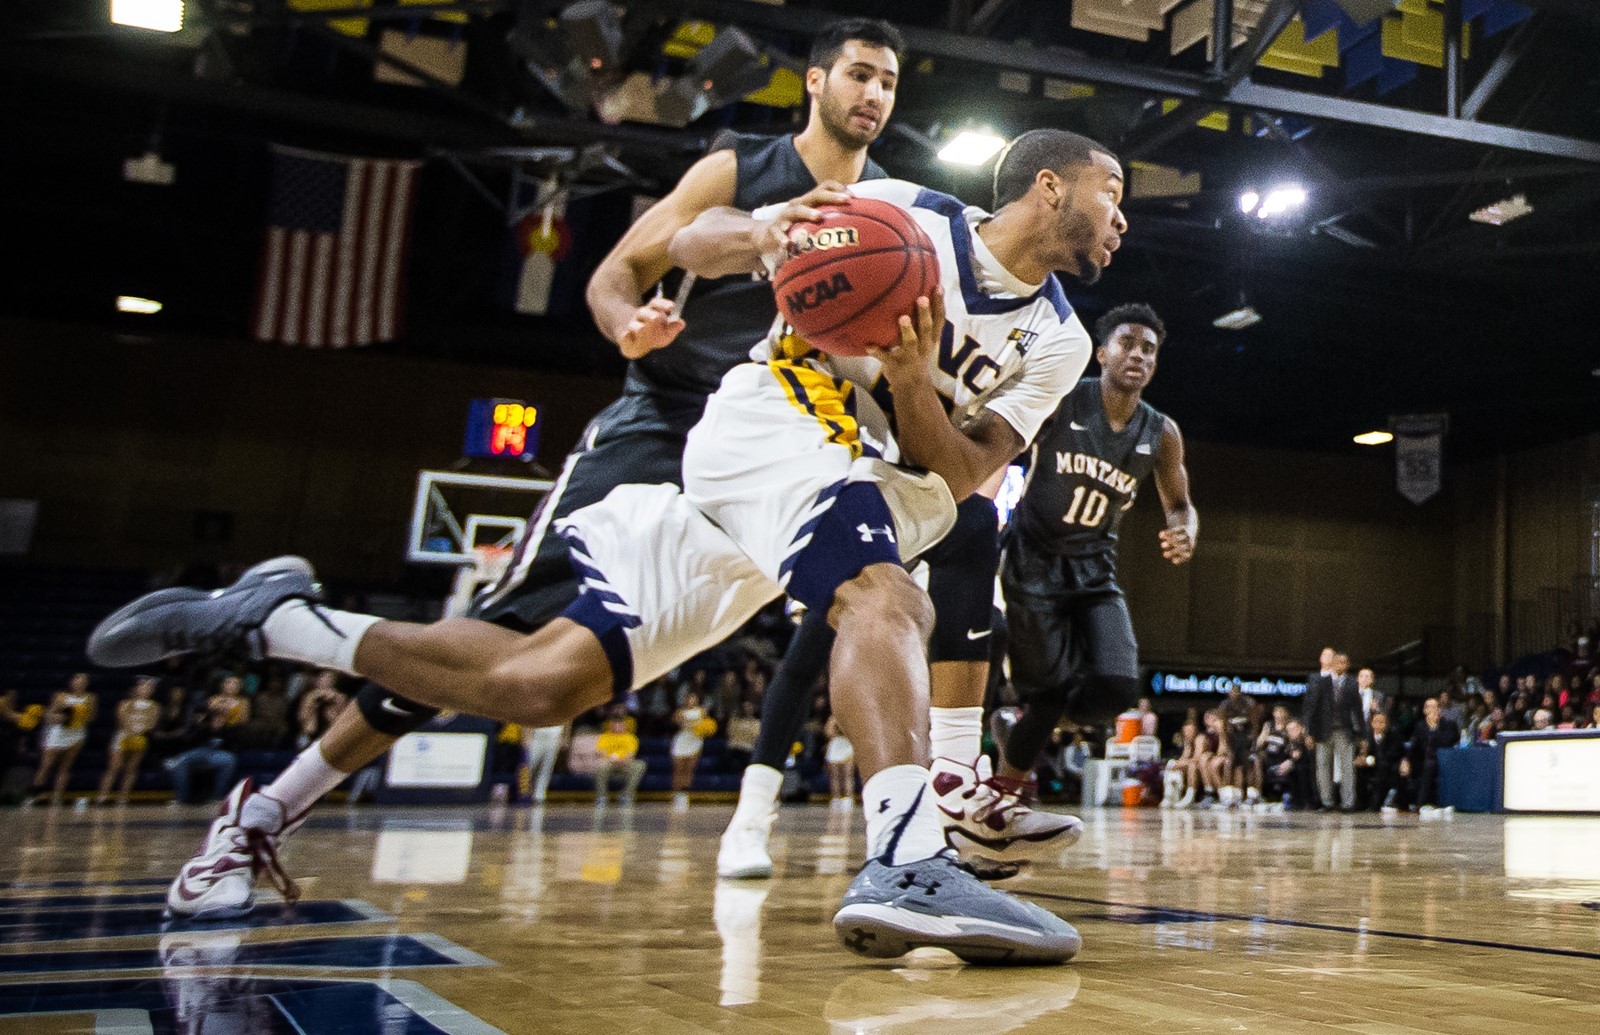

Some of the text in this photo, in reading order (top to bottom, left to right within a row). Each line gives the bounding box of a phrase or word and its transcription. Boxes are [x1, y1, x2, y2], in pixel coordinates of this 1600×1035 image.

[786, 272, 853, 314] NCAA
[938, 318, 1001, 396] NC
[1063, 485, 1109, 527] 10
